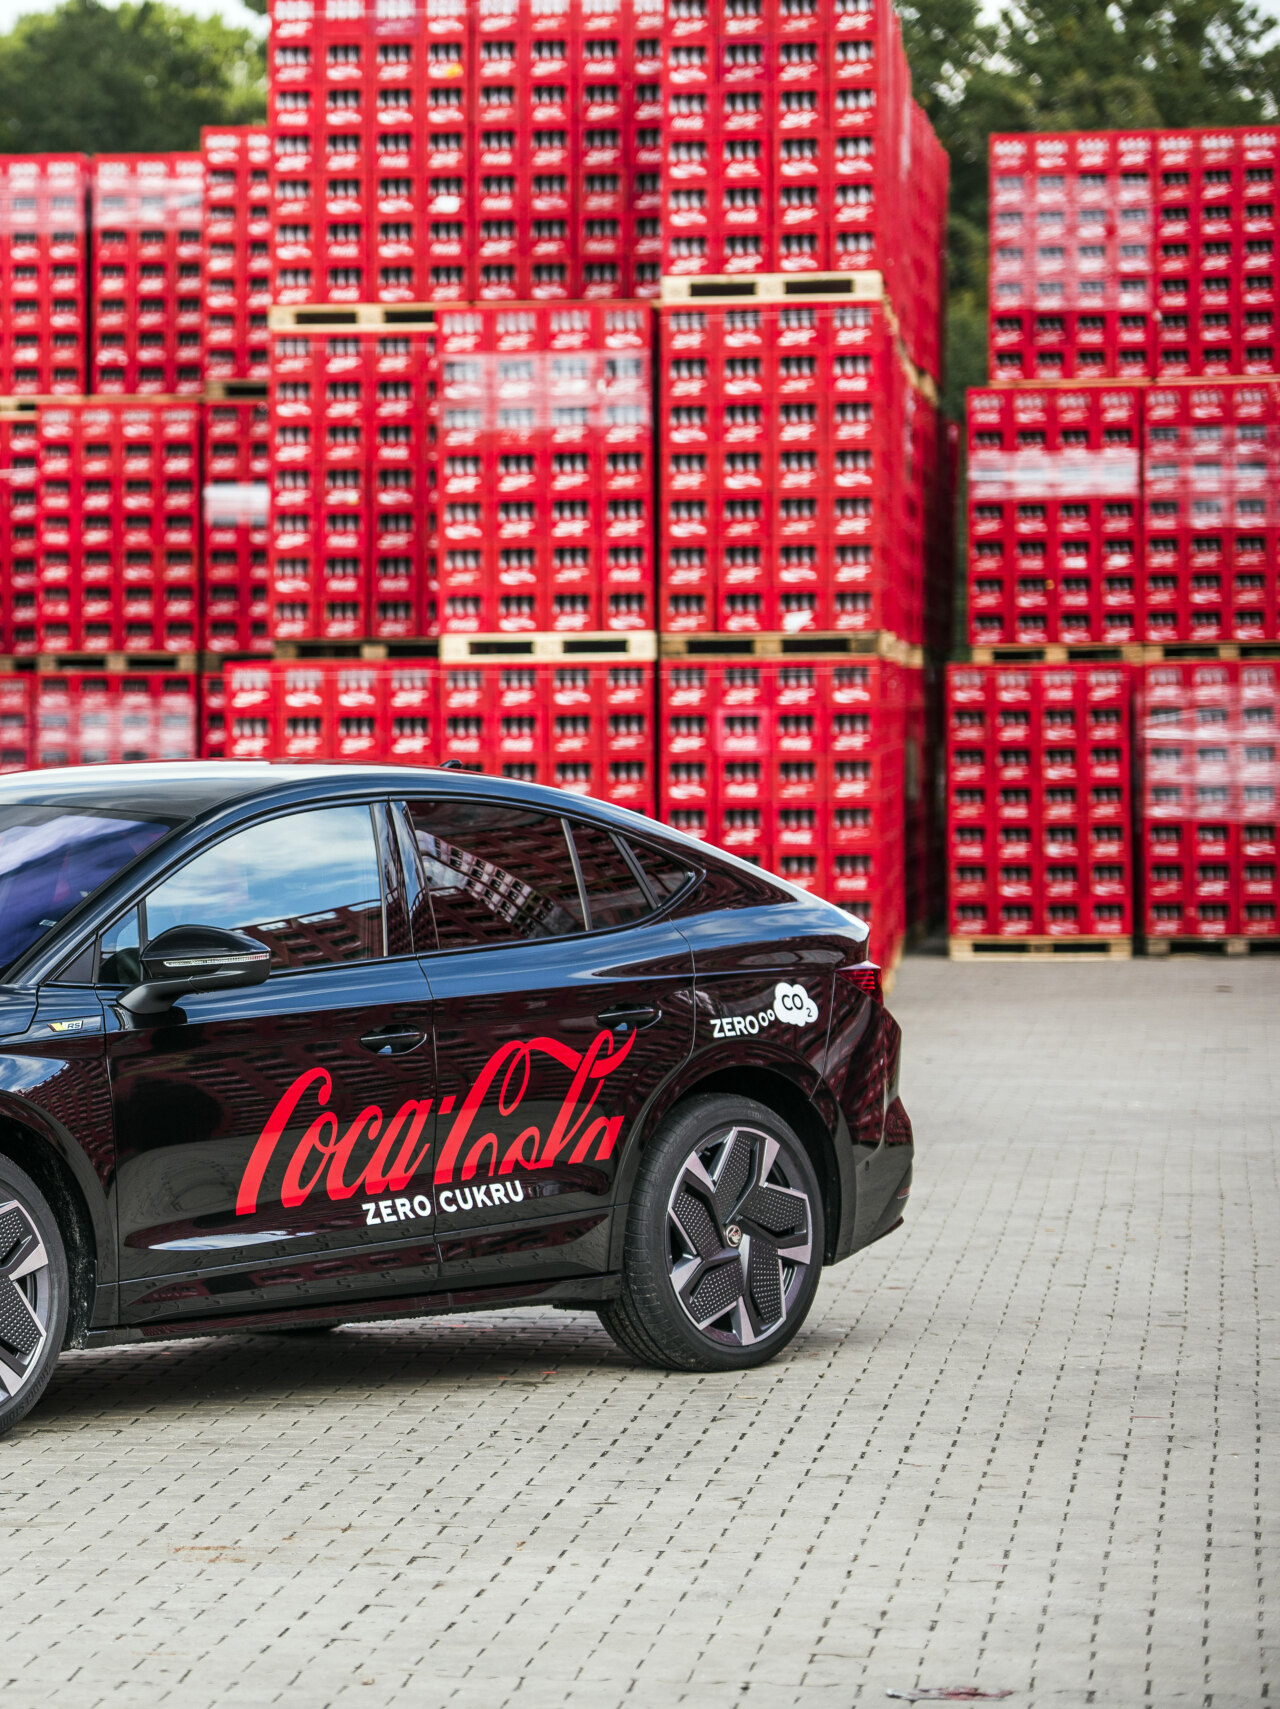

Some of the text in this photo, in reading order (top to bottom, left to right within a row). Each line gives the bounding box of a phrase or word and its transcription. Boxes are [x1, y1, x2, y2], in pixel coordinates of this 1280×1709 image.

[236, 1026, 637, 1216] Coca-Cola
[361, 1180, 525, 1226] ZERO CUKRU
